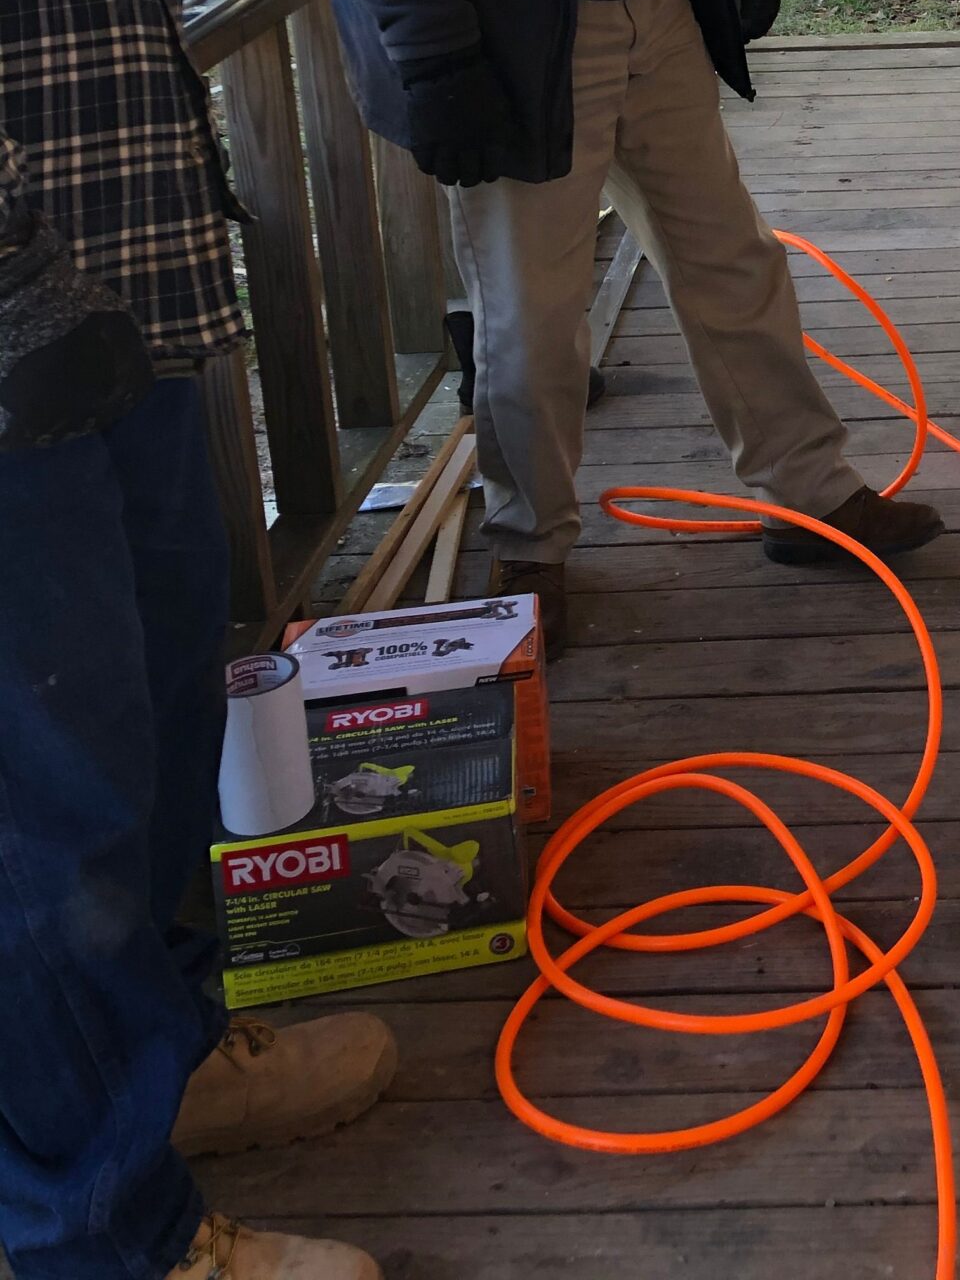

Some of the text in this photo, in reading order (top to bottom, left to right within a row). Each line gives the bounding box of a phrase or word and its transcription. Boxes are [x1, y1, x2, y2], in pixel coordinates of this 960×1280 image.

[317, 621, 372, 634] LIFETIME
[376, 641, 428, 656] 100%
[233, 660, 275, 675] Nashua
[332, 702, 422, 728] RYOBI
[336, 728, 382, 739] CIRCULAR
[228, 843, 341, 886] RYOBI
[225, 884, 332, 907] 7-1/4 in. CIRCULAR SAW
[226, 901, 277, 915] with LASER
